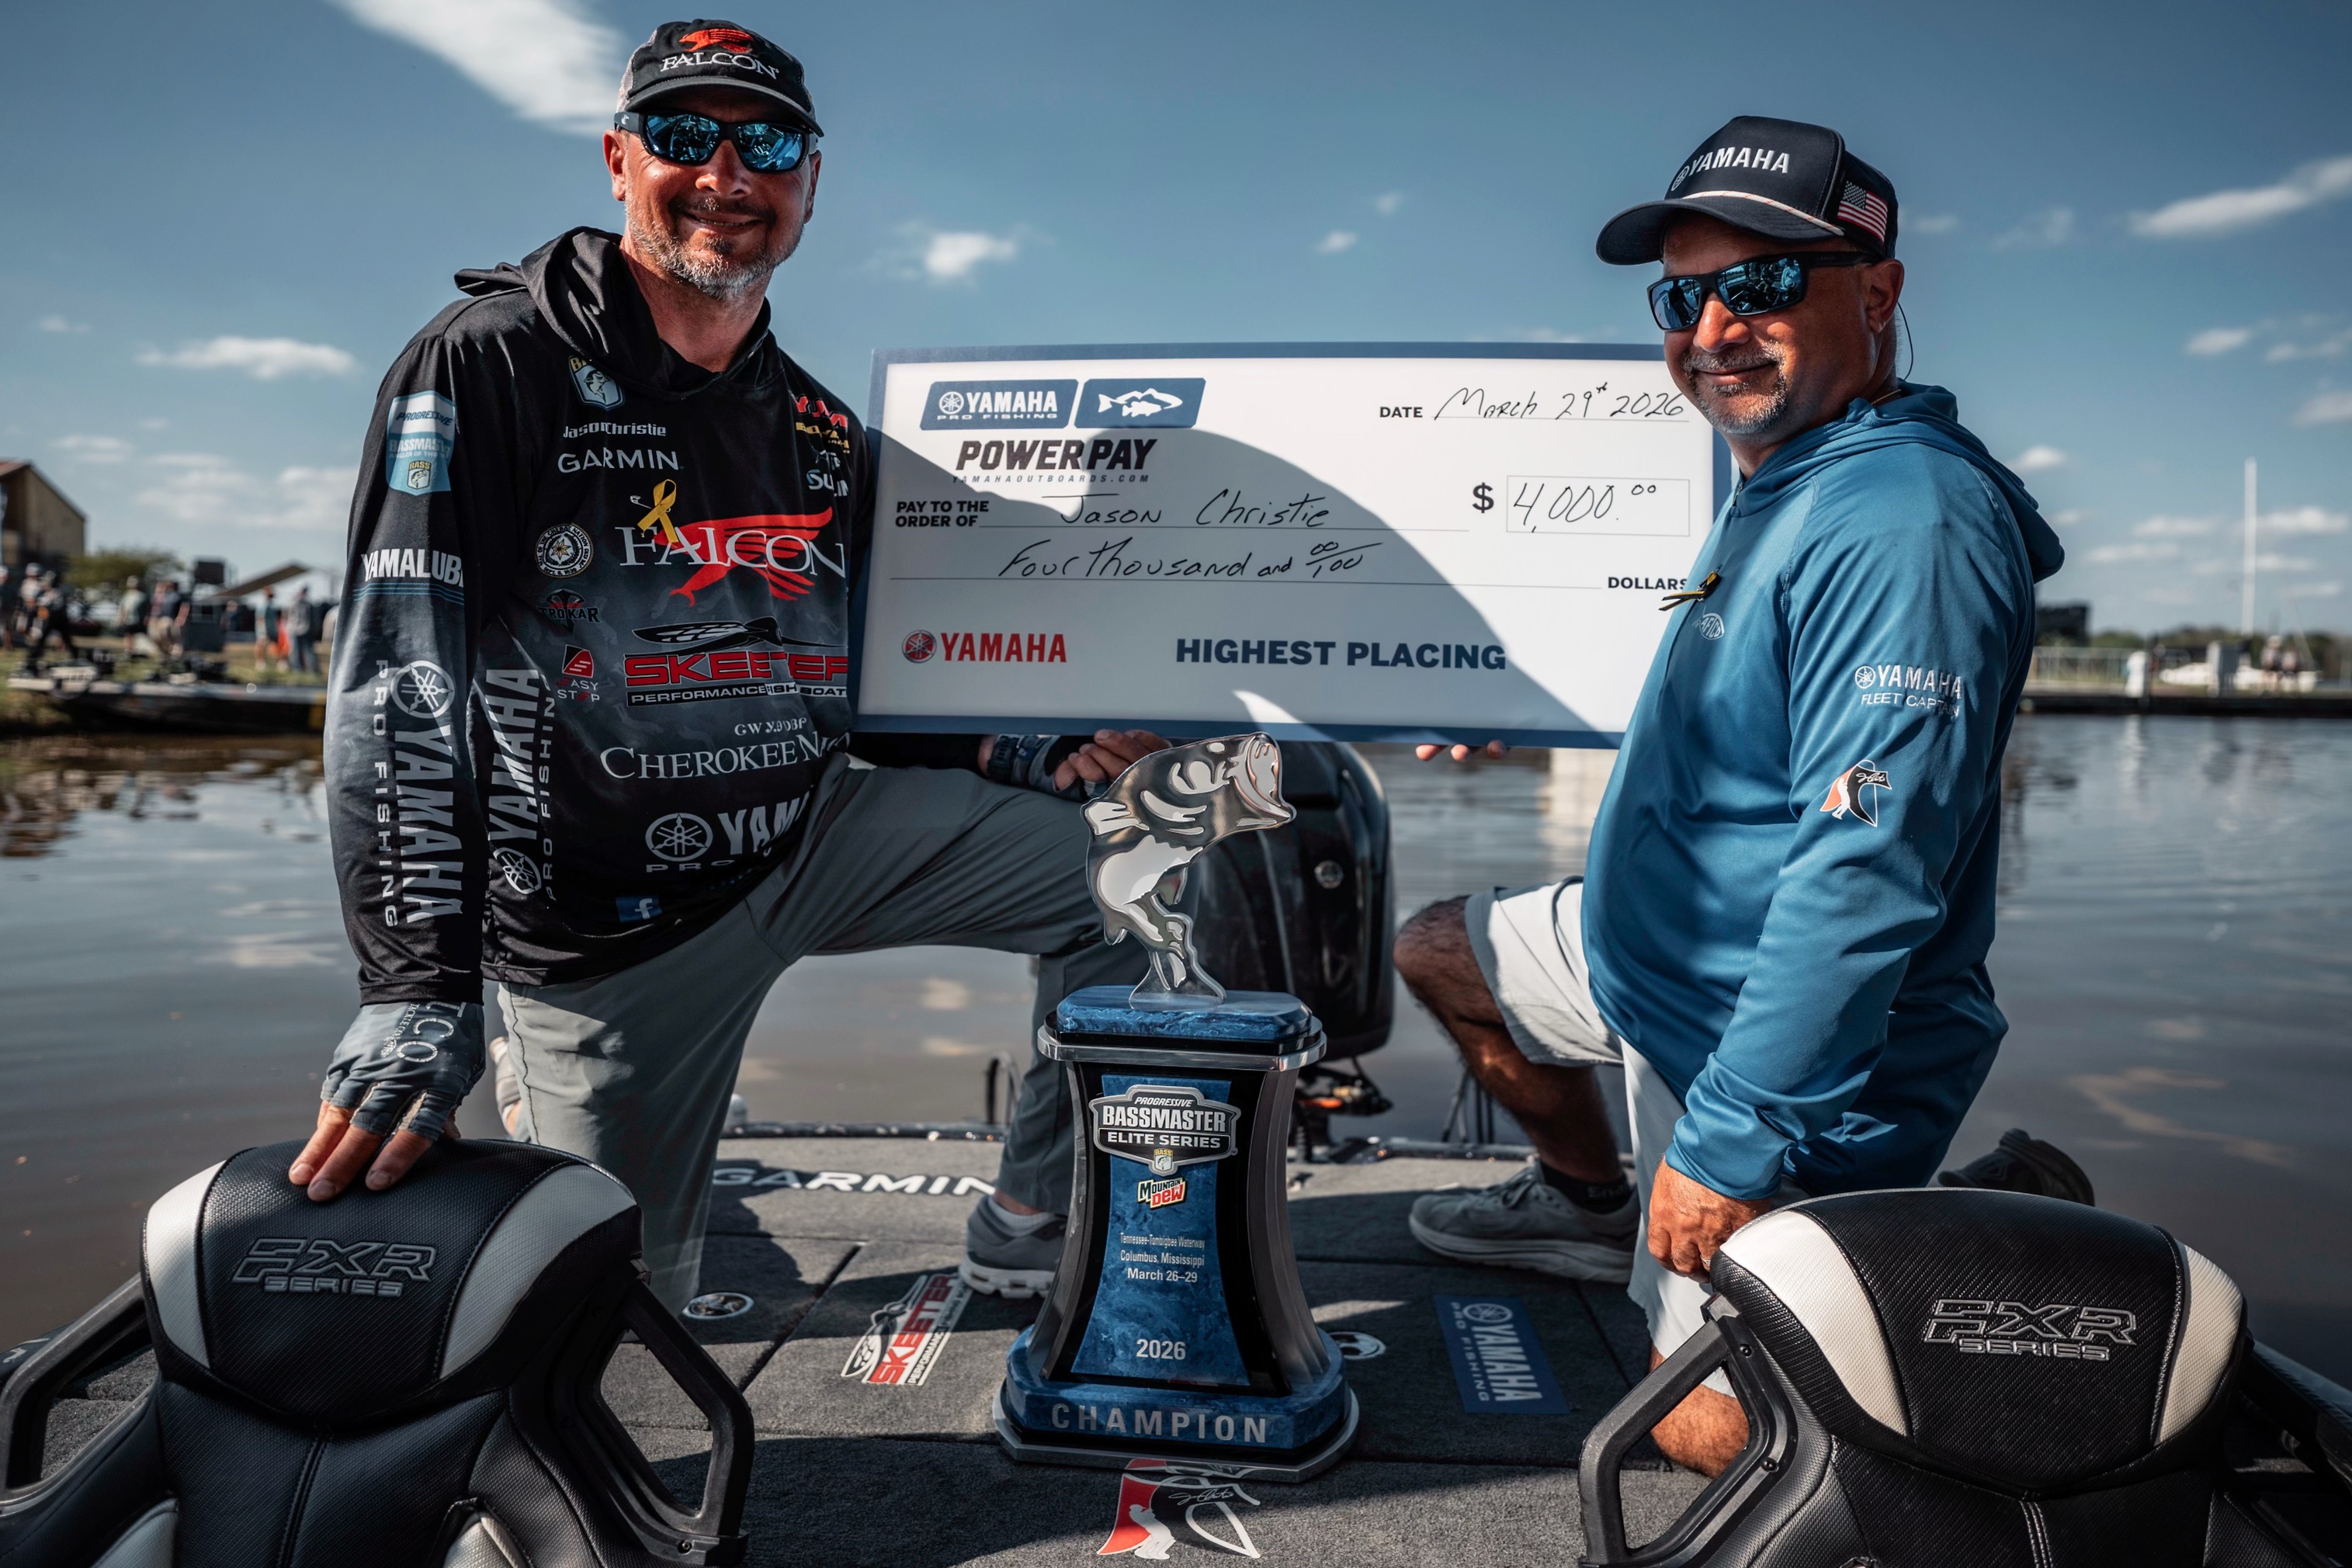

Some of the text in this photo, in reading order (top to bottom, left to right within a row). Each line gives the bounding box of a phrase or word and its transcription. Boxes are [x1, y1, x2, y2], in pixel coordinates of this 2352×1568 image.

[661, 52, 779, 80] FALCON
[1688, 147, 1790, 176] YAMAHA
[966, 390, 1058, 414] YAMAHA
[1379, 406, 1423, 418] DATE
[1610, 392, 1684, 419] 2026
[409, 461, 431, 470] BASS
[557, 447, 679, 474] GARMIN
[956, 439, 1157, 471] POWER PAY
[952, 474, 1150, 484] YAMAHAOUTBOARDS.COM
[897, 501, 990, 512] PAY TO THE
[1041, 488, 1330, 527] Jason Christie
[1472, 482, 1495, 514] $
[895, 516, 978, 528] ORDER OF
[615, 526, 846, 578] FALCON
[360, 548, 464, 588] YAMALUB
[1258, 556, 1292, 578] and
[940, 632, 1067, 663] YAMAHA
[1176, 639, 1506, 669] HIGHEST PLACING
[631, 686, 766, 703] PERFORMANCE
[1878, 664, 1962, 699] YAMAHA
[1861, 692, 1961, 717] FLEET CAPTAIN
[486, 669, 540, 841] YAMAHA
[600, 739, 803, 779] CHEROKEE
[372, 660, 398, 928] PRO FISHING
[394, 724, 464, 924] YAMAHA
[646, 859, 735, 872] PRO
[1134, 1097, 1192, 1107] PROGRESSIVE
[1102, 1105, 1226, 1132] BASSMASTER
[1108, 1132, 1221, 1148] ELITE SERIES
[712, 1167, 996, 1196] GARMIN
[1178, 1236, 1205, 1251] Waterway
[234, 1238, 437, 1282] FXR
[1120, 1250, 1205, 1268] Columbus, Mississippi
[264, 1276, 404, 1297] SERIES
[1127, 1268, 1164, 1280] March
[1923, 1299, 2137, 1345] FXR
[1136, 1339, 1186, 1361] 2026
[1471, 1323, 1543, 1401] YAMAHA
[1959, 1338, 2110, 1362] SERIES
[1052, 1403, 1267, 1443] CHAMPION
